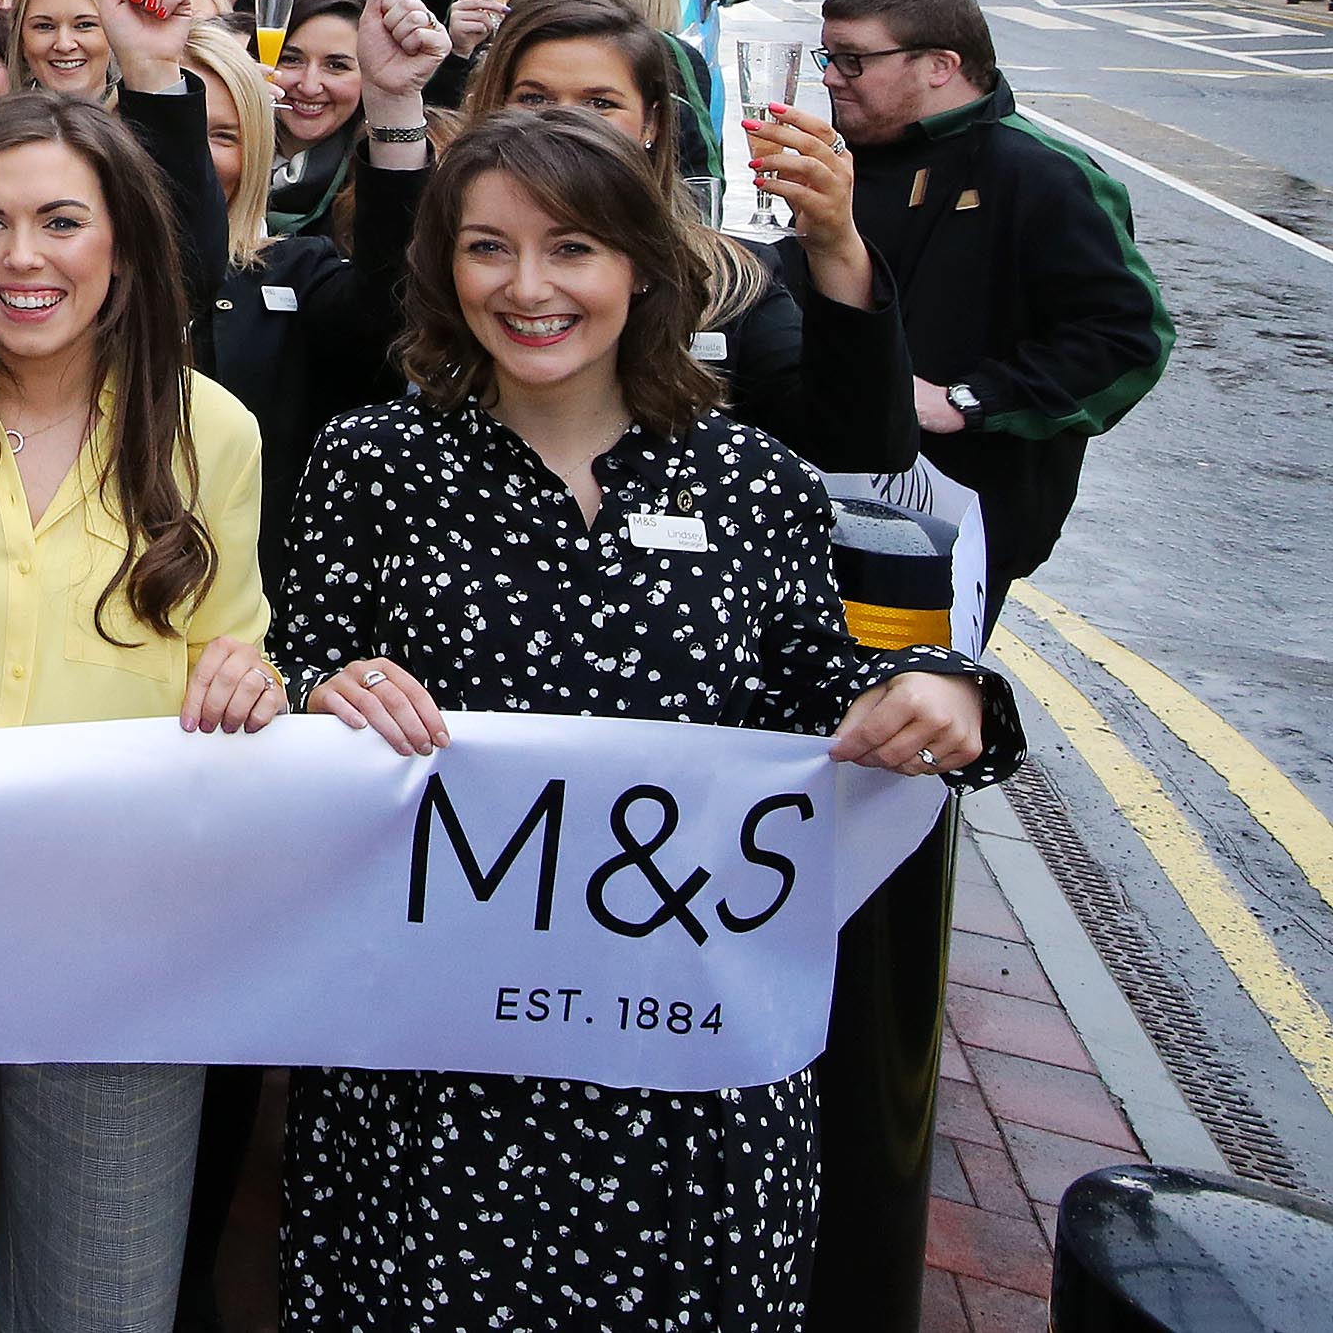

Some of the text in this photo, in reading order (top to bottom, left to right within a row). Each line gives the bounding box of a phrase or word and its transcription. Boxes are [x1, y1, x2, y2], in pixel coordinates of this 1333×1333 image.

[633, 516, 657, 527] M&S
[667, 530, 703, 541] Lindsey
[407, 771, 815, 947] M&S
[495, 987, 723, 1035] EST. 1884
